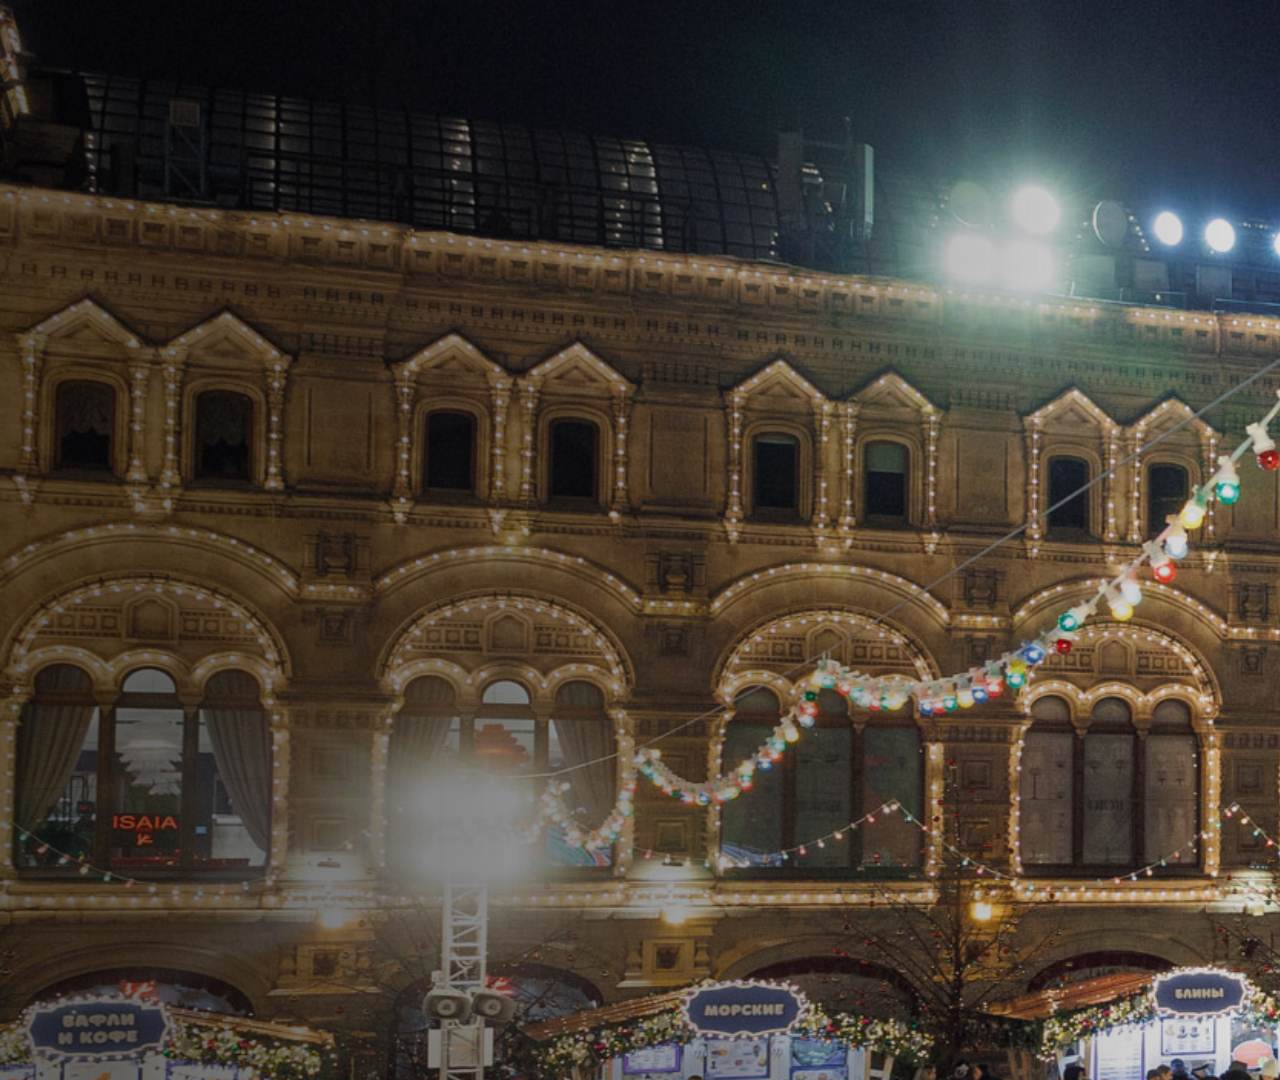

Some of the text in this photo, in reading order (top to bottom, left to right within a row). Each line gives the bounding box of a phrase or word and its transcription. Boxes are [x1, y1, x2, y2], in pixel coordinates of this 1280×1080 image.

[113, 816, 177, 829] ISAIA
[1174, 988, 1224, 999] БЛИНЫ
[704, 1003, 784, 1016] МОРСКИЕ
[62, 1013, 135, 1027] ВАФЛИ
[58, 1030, 138, 1045] И КОФЕ
